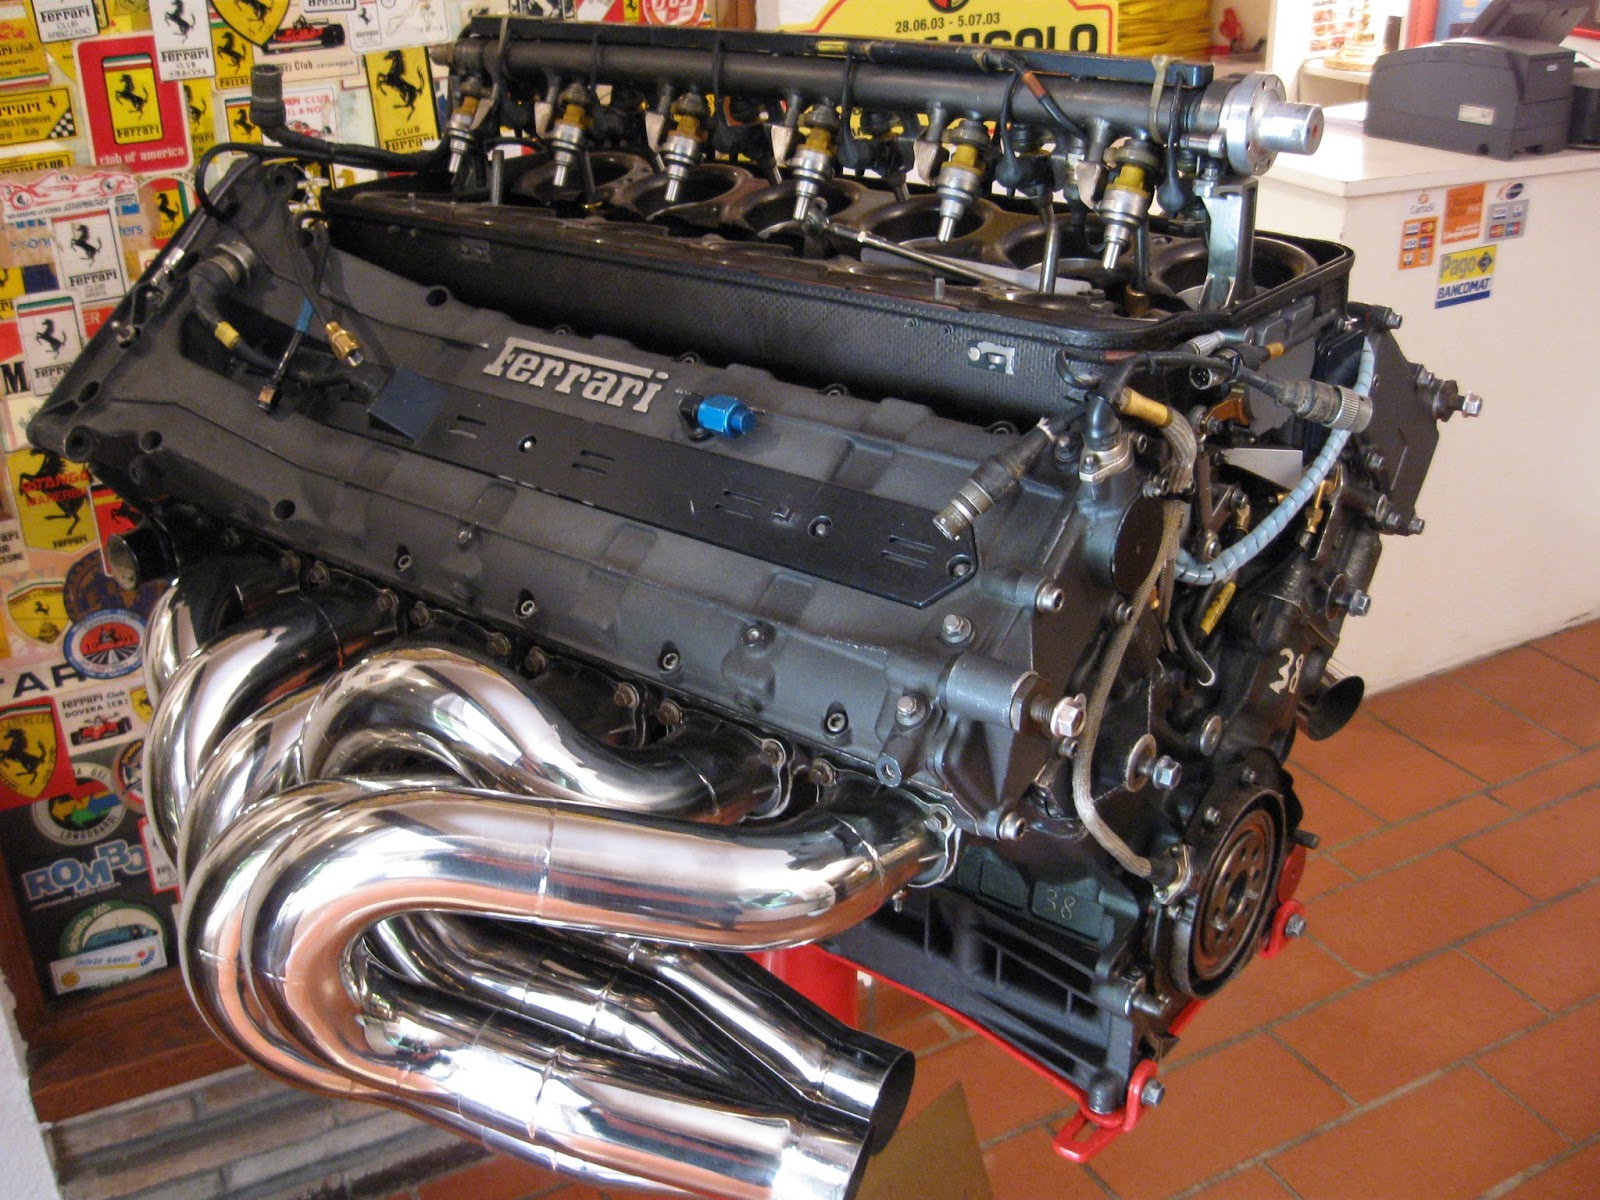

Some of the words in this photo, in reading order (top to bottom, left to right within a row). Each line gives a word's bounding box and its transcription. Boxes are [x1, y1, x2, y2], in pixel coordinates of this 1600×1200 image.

[40, 5, 91, 23] Ferrari
[895, 17, 945, 34] 28.06.03
[957, 12, 1001, 28] 5.07.03
[160, 47, 210, 63] Ferrari
[219, 75, 250, 88] Ferrar
[287, 105, 323, 117] ILANO
[116, 125, 160, 139] Ferrari
[395, 126, 421, 137] CLUB
[384, 133, 435, 151] Ferrari
[100, 154, 122, 166] club
[125, 152, 137, 163] of
[140, 147, 185, 161] america
[1440, 254, 1477, 280] Pago
[69, 269, 118, 287] Ferrari
[1437, 278, 1492, 300] BANCOMAT
[482, 336, 670, 413] Ferrari
[62, 693, 103, 709] Ferrari
[107, 689, 126, 699] Club
[65, 705, 104, 719] DOVERA
[22, 839, 150, 902] ROMBO
[1046, 888, 1076, 921] 38
